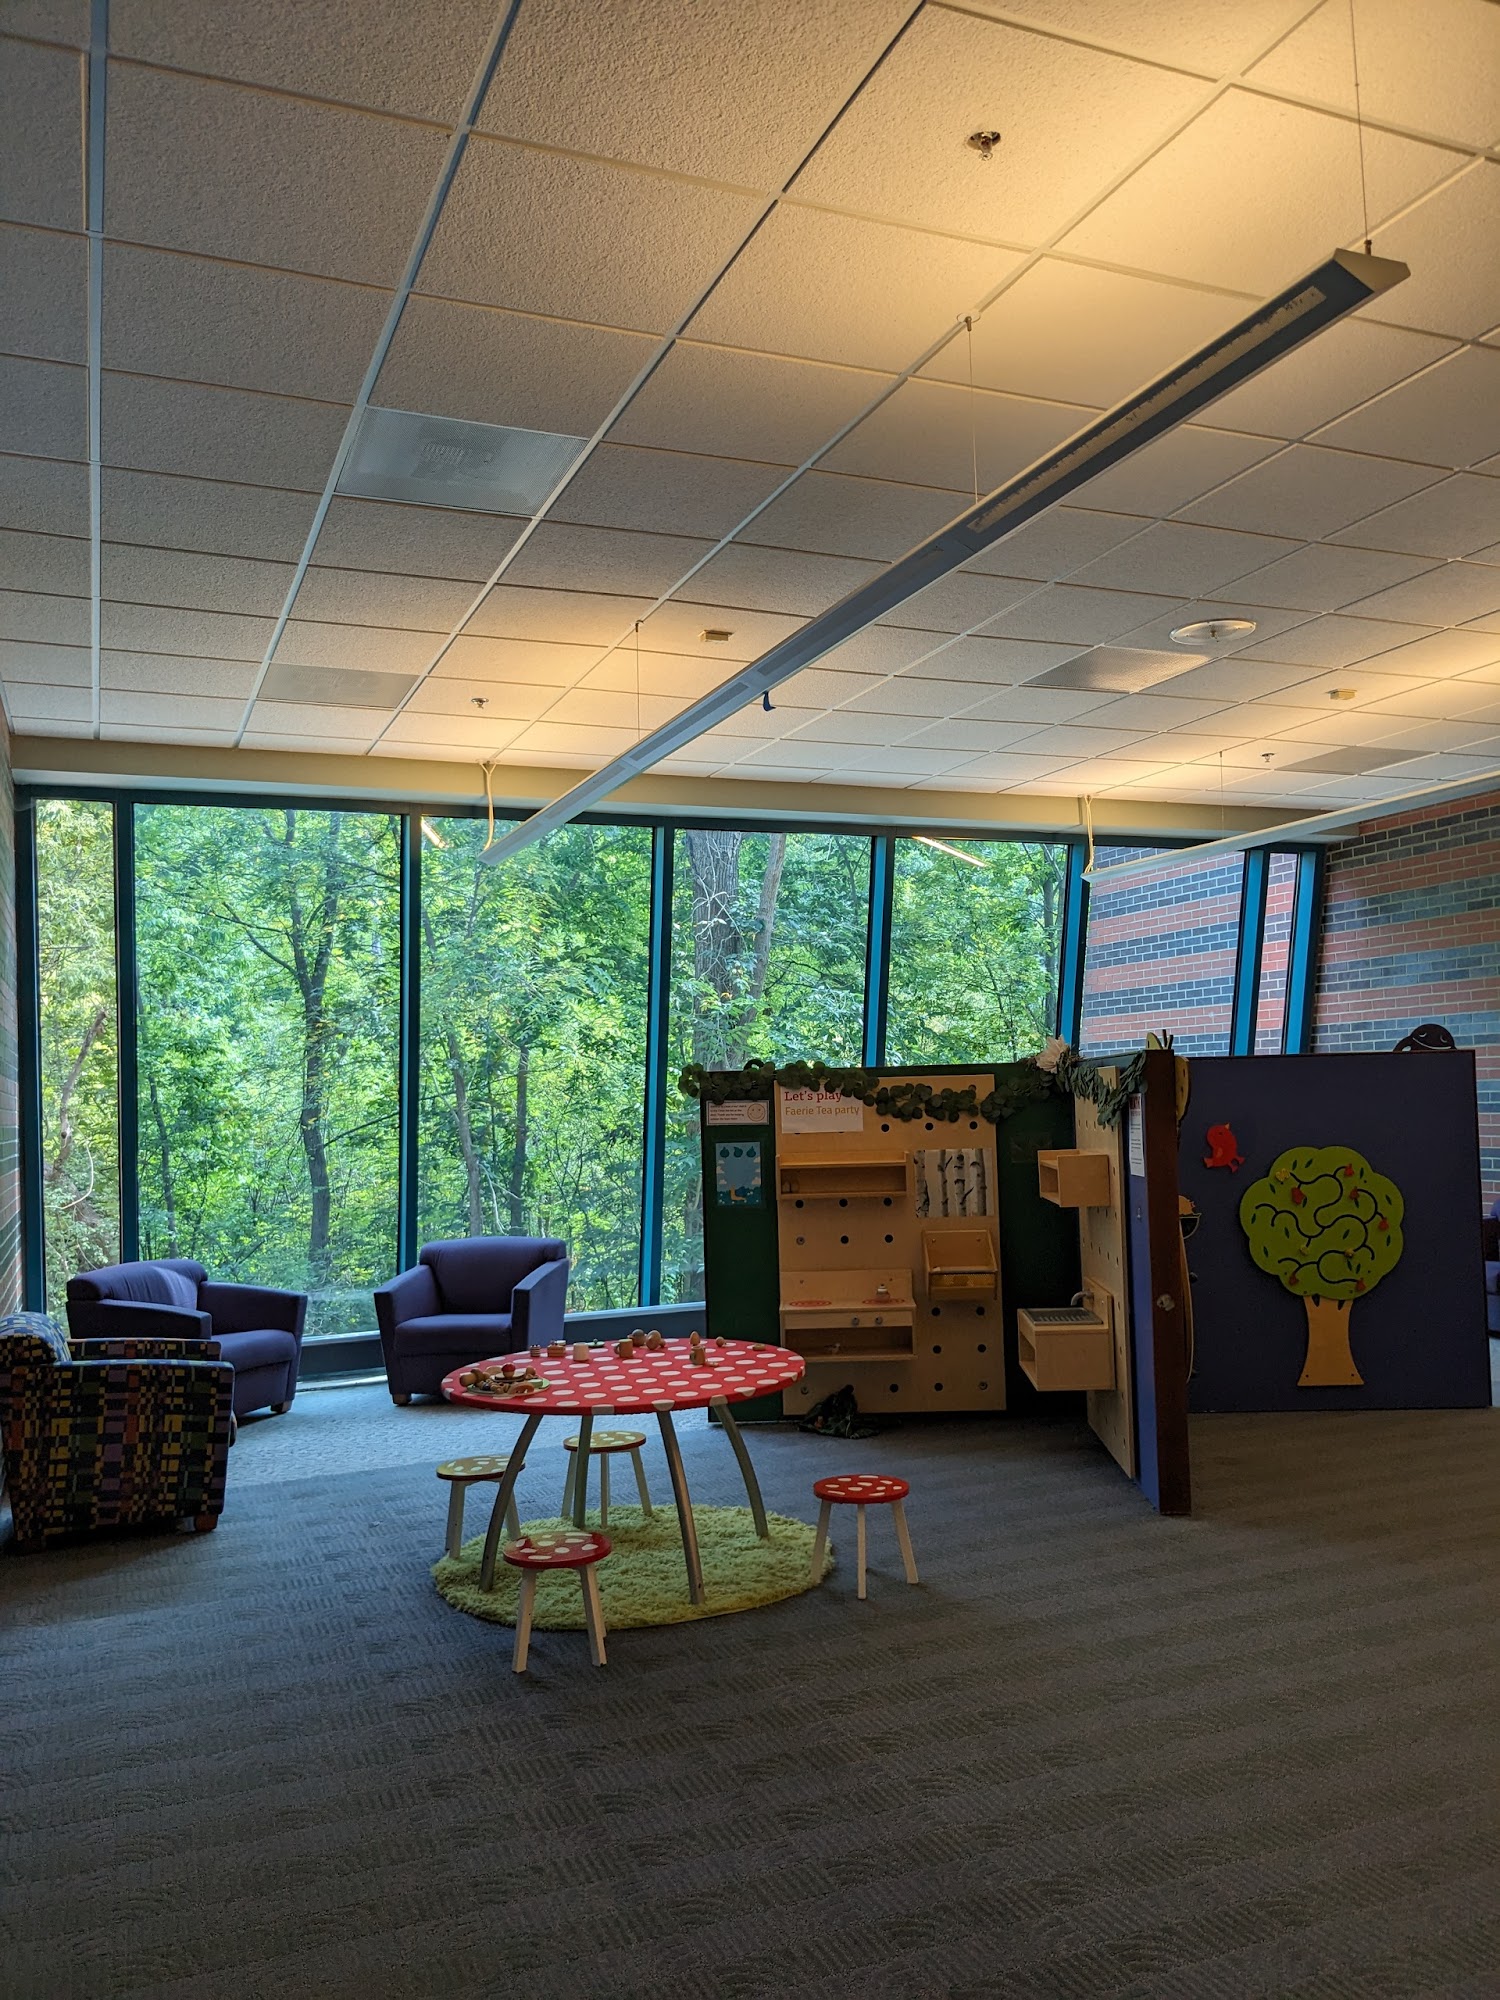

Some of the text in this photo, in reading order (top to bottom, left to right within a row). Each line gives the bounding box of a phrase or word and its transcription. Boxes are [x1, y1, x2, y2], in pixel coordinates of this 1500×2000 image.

[784, 1091, 842, 1103] Let's play
[785, 1105, 860, 1116] Faerie Tea party
